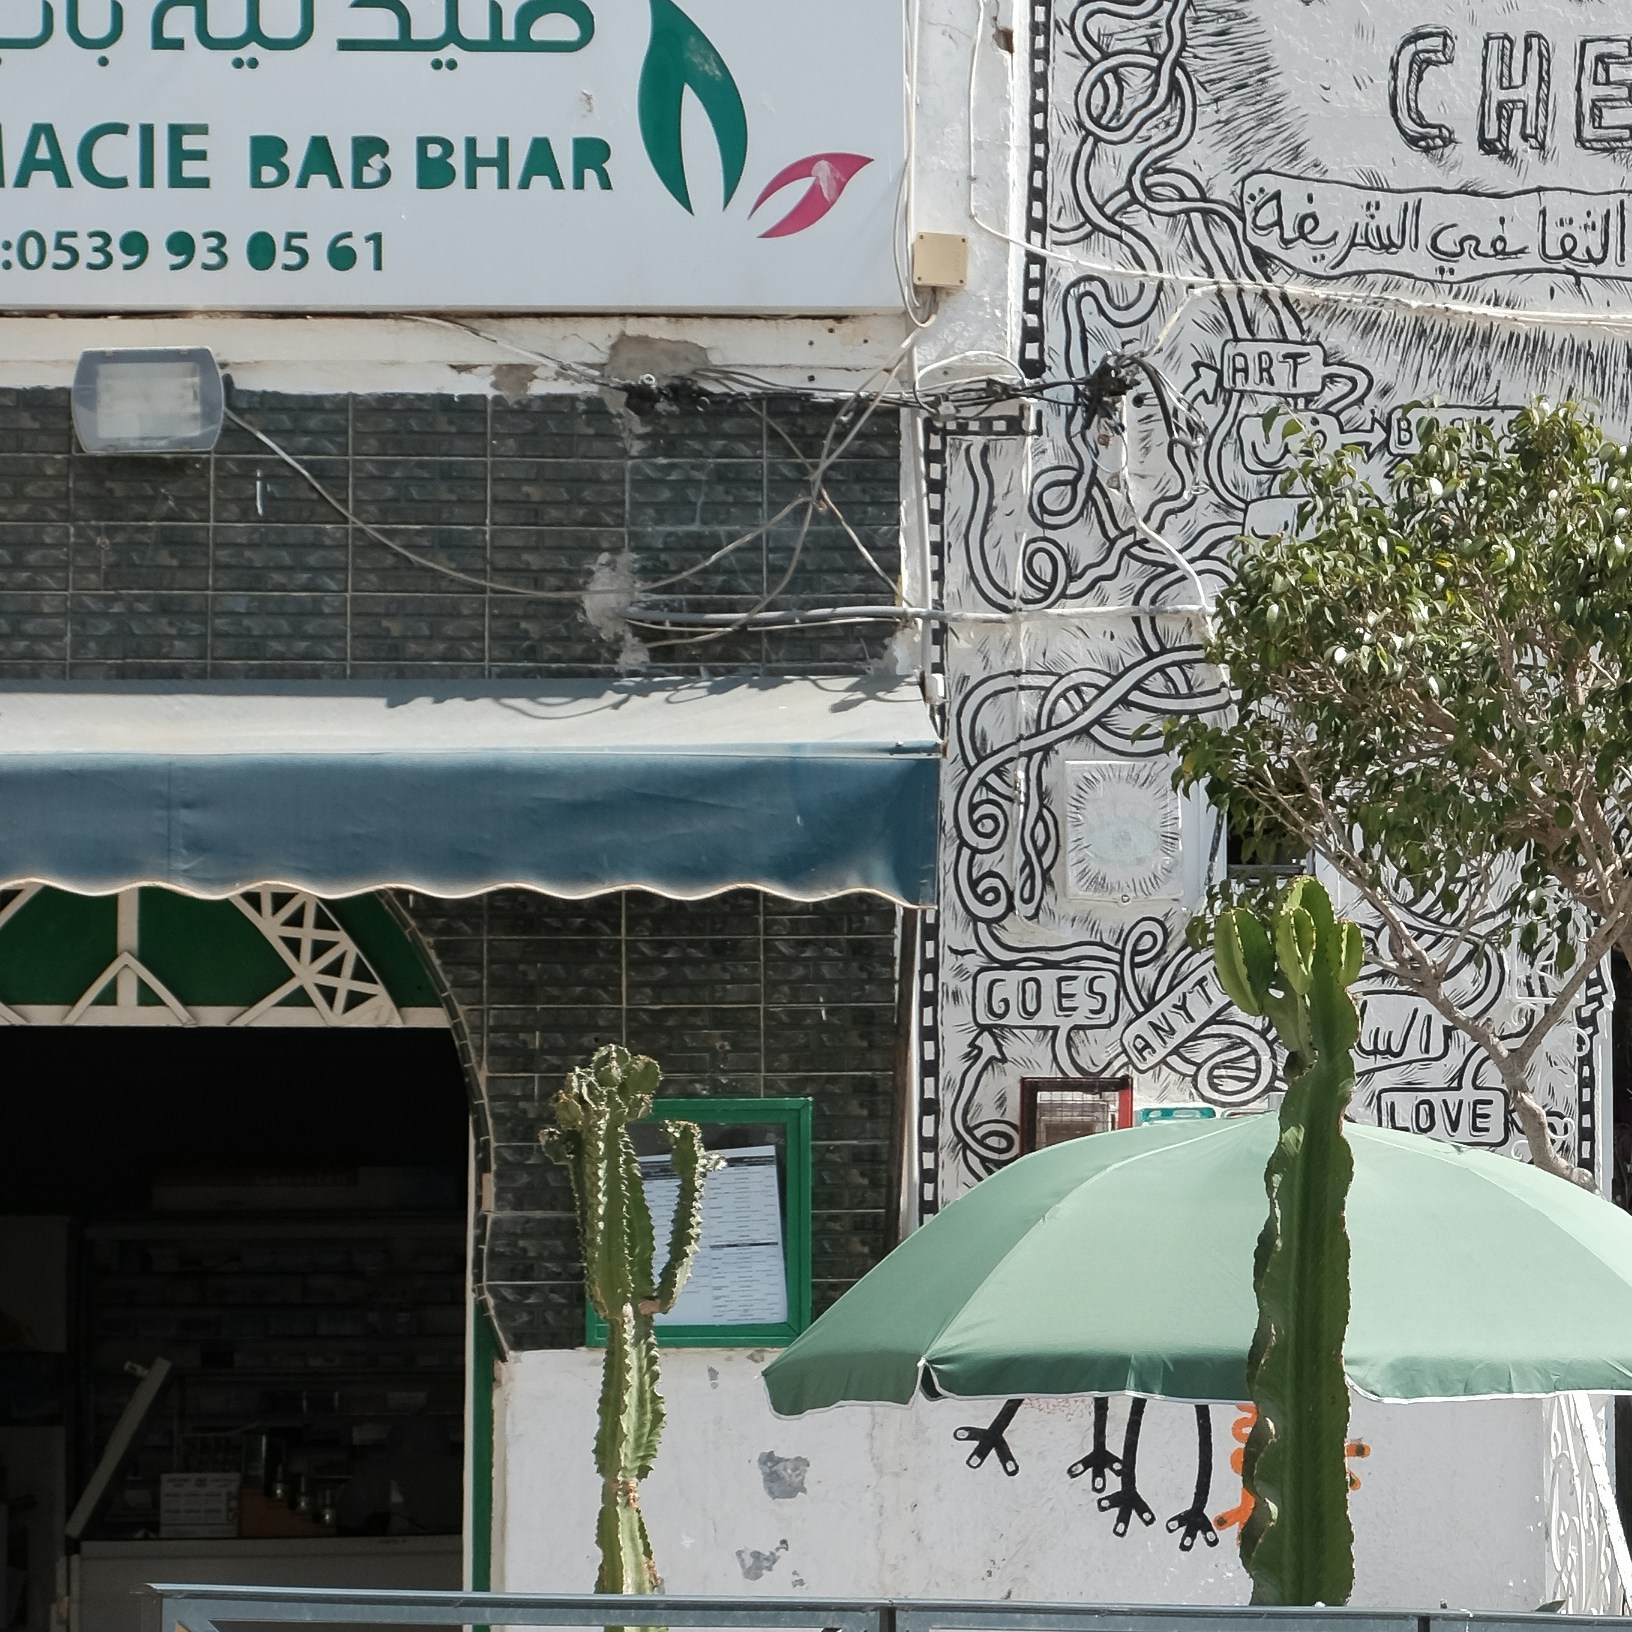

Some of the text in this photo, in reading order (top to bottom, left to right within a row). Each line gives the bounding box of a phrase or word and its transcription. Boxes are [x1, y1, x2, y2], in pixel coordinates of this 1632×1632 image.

[0, 121, 613, 190] ACIE BAB BHAR
[166, 229, 228, 271] 93
[246, 229, 309, 271] 05
[325, 229, 384, 271] 61
[1229, 351, 1312, 390] ART
[986, 974, 1108, 1021] GOES
[1132, 967, 1222, 1063] ANYT
[1388, 1098, 1495, 1134] LOVE
